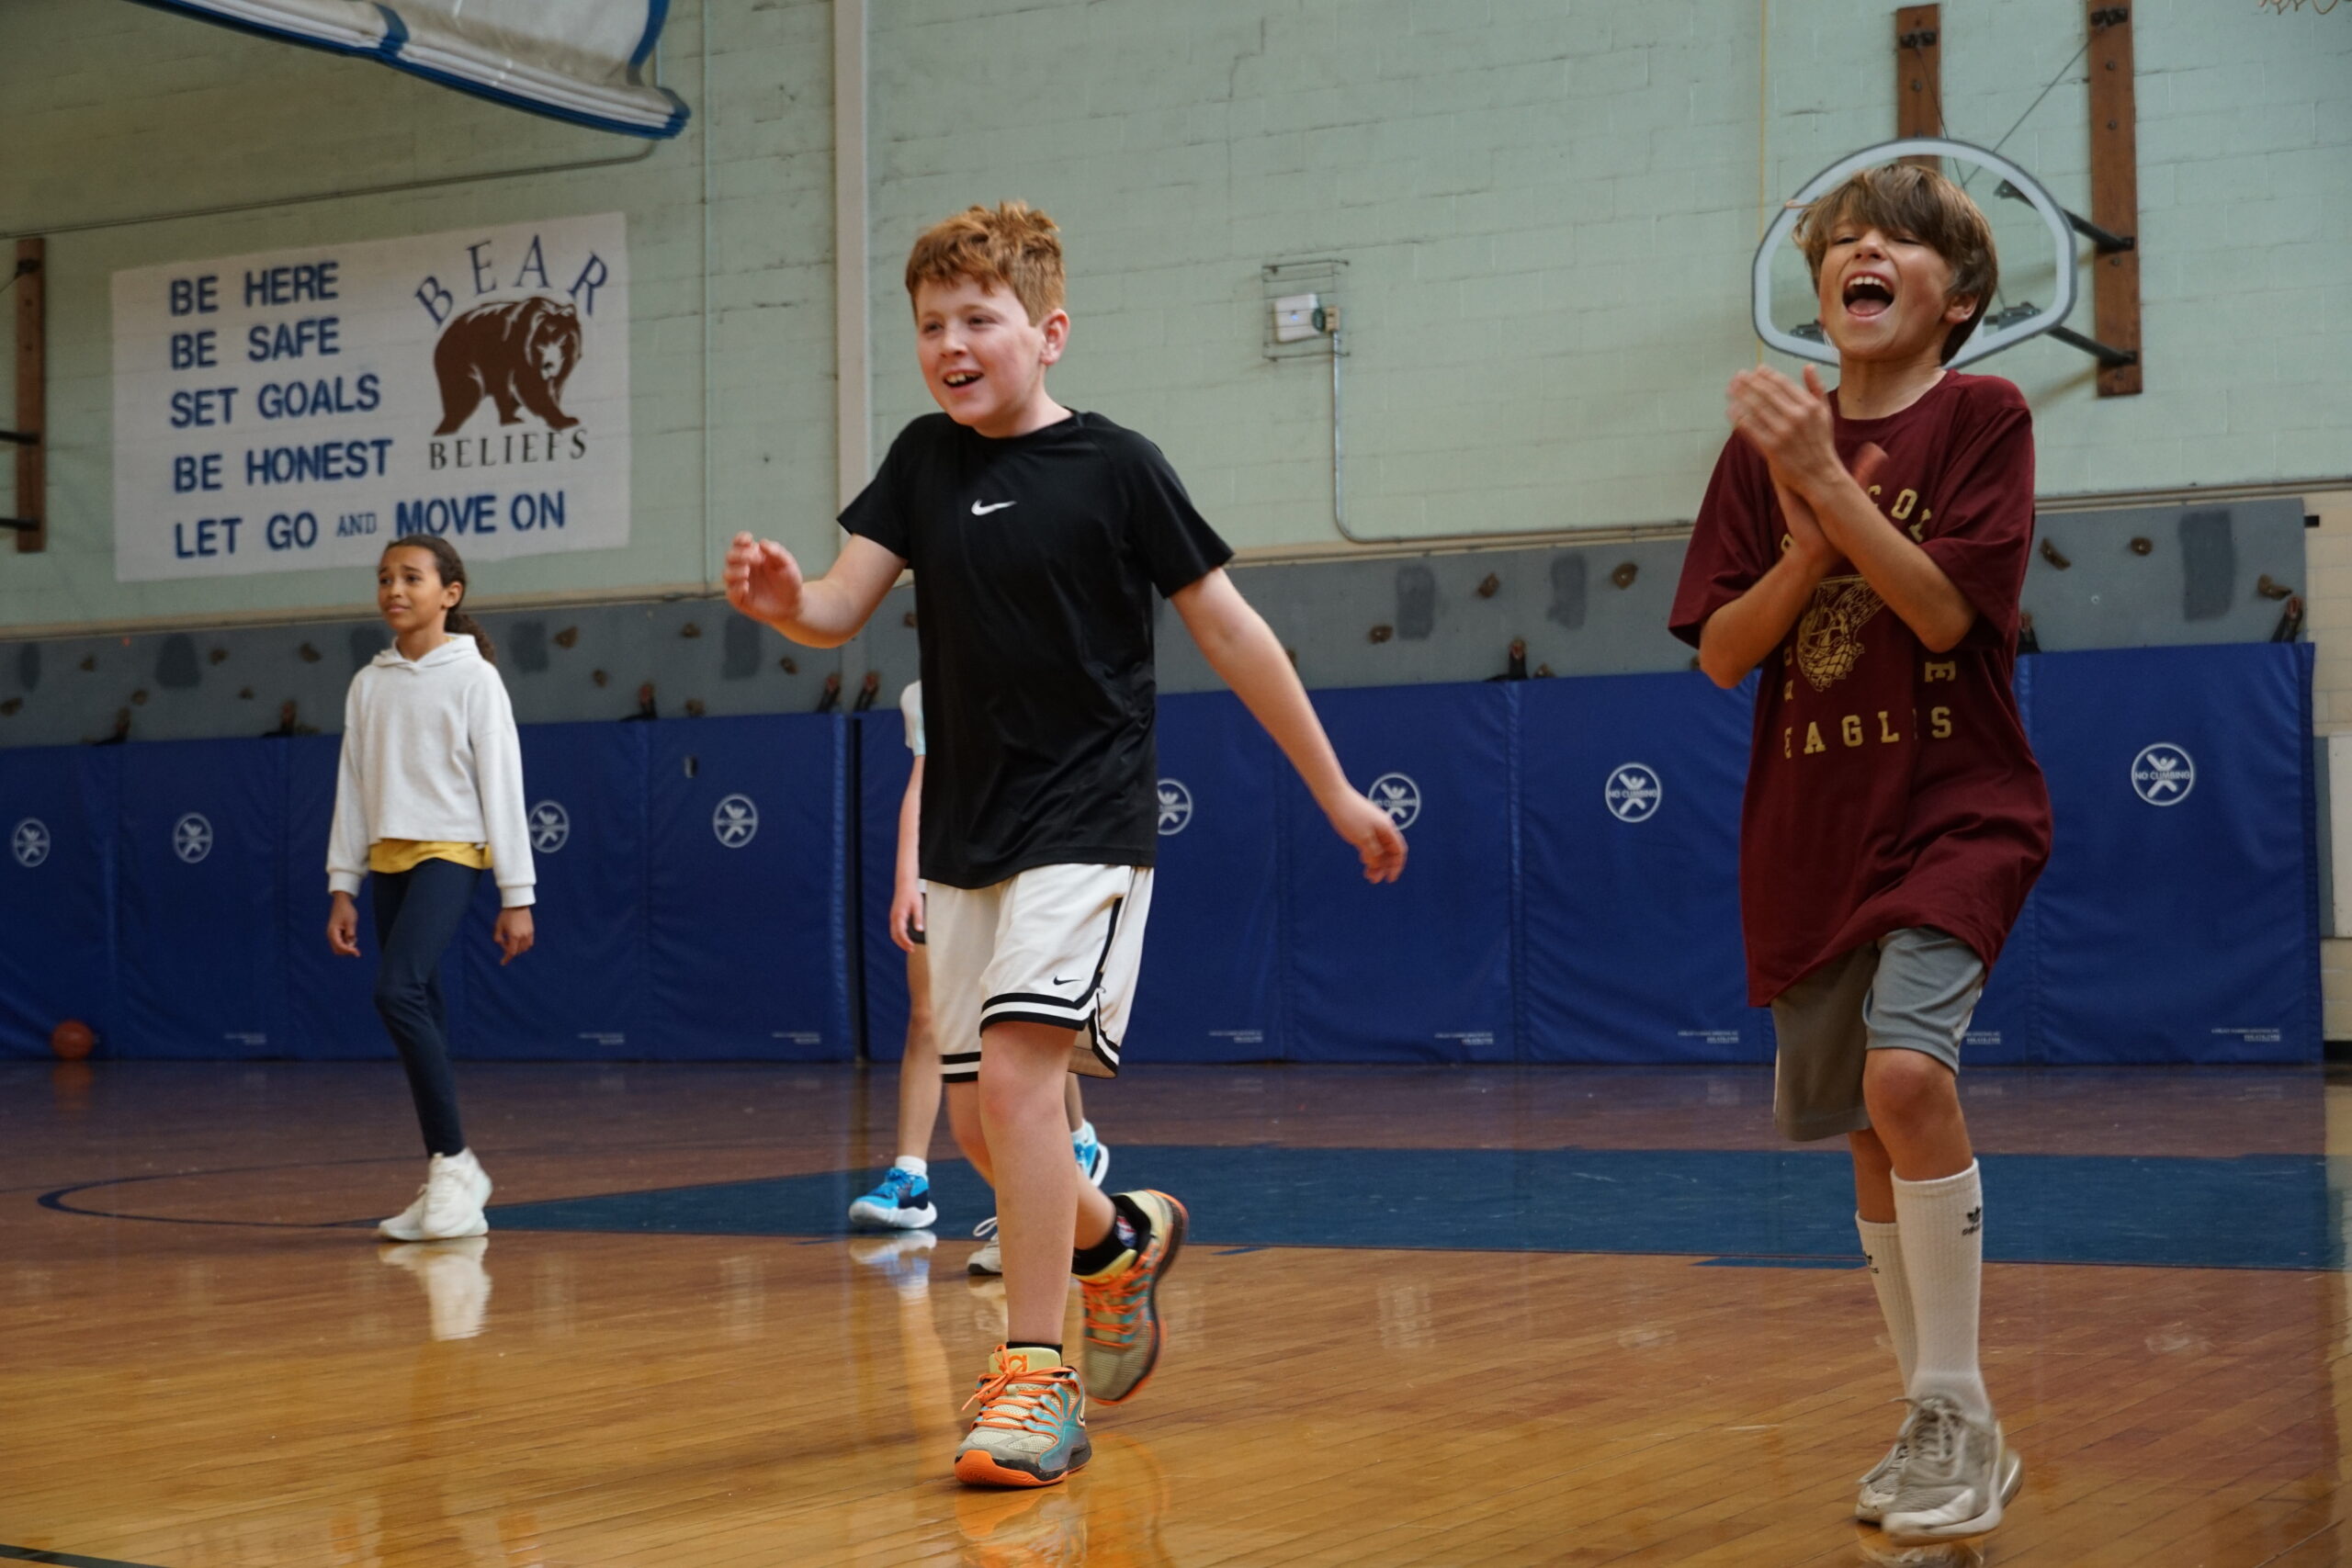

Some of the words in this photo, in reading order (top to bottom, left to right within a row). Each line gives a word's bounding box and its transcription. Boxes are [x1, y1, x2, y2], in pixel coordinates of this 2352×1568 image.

[171, 276, 219, 316] BE
[244, 262, 339, 307] HERE
[414, 233, 608, 327] BEAR
[171, 331, 218, 370] BE
[248, 317, 340, 362] SAFE
[171, 388, 238, 428] SET
[258, 374, 379, 419] GOALS
[175, 454, 222, 493] BE
[246, 439, 393, 486] HONEST
[429, 429, 588, 470] BELIEFS
[175, 517, 243, 558] LET
[266, 512, 318, 551] GO
[336, 513, 377, 537] AND
[396, 495, 497, 538] MOVE
[511, 491, 565, 531] ON
[1784, 706, 1952, 759] AGLS
[2134, 771, 2148, 780] NO
[2150, 770, 2190, 780] CLIMBING
